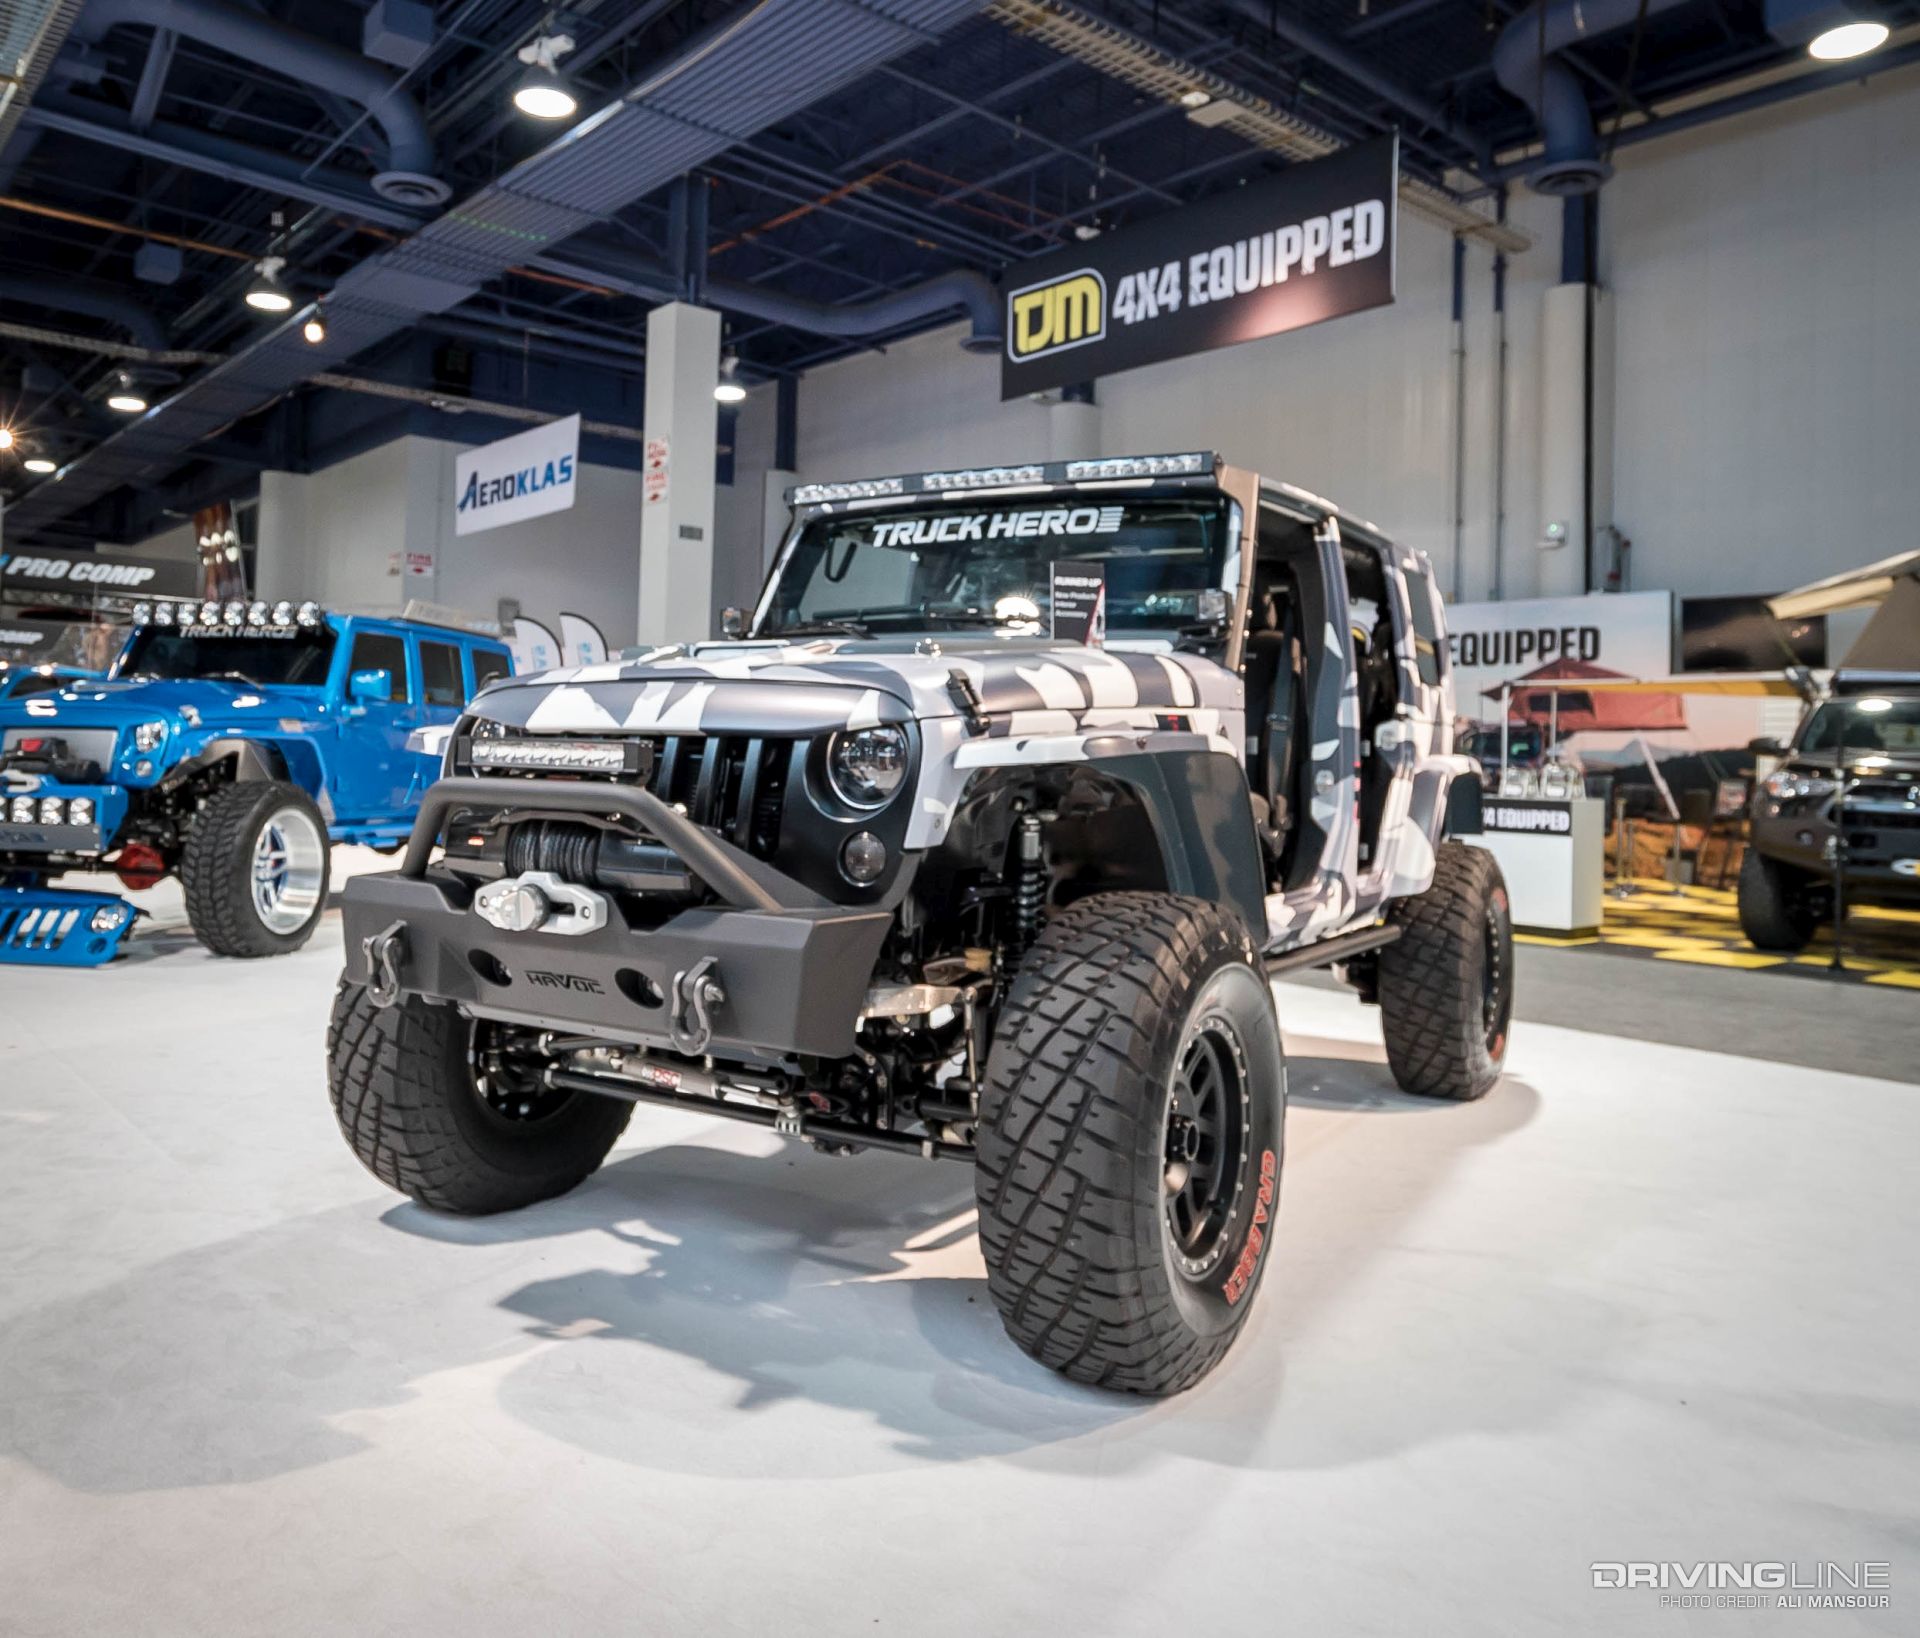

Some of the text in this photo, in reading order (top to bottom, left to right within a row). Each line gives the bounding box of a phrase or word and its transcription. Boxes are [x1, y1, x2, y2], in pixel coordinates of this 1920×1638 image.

[1112, 260, 1182, 325] 4X4
[1188, 199, 1385, 307] EQUIPPED
[457, 454, 574, 514] AEROKLAS
[873, 507, 1100, 548] TRUCK HERO
[5, 556, 156, 586] PRO COMP
[1449, 625, 1601, 667] EQUIPPED
[1496, 808, 1570, 831] EQUIPPED
[524, 970, 606, 995] HAVOC
